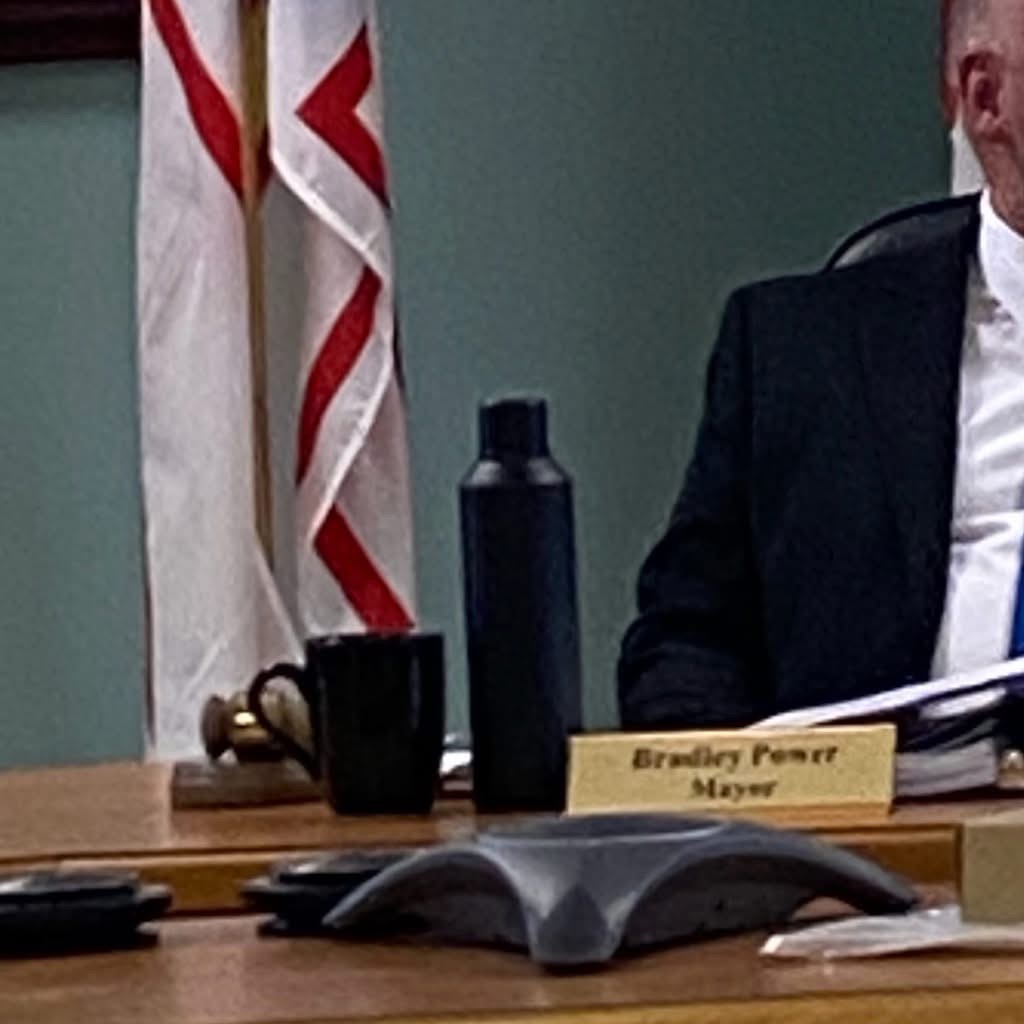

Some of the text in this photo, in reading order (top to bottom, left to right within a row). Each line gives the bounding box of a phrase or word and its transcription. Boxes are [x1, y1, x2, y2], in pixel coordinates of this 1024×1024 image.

[632, 742, 838, 773] Bradley Power
[691, 776, 778, 802] Mayor
